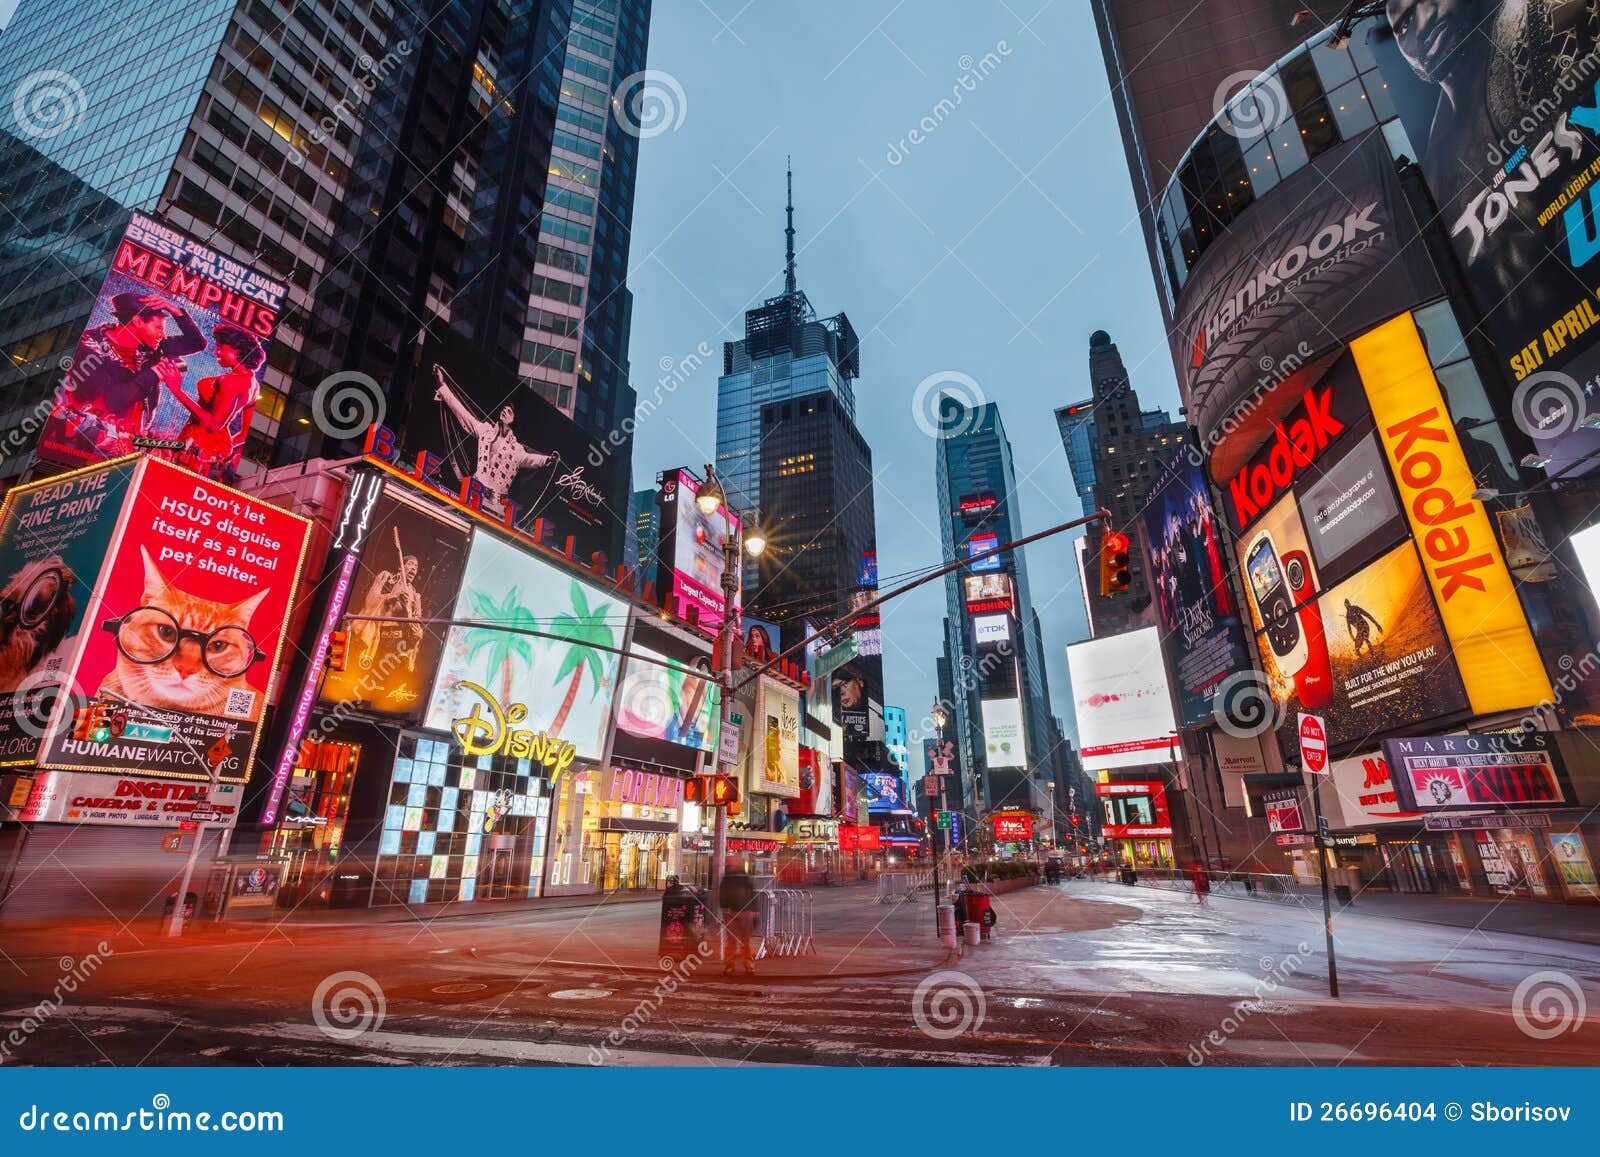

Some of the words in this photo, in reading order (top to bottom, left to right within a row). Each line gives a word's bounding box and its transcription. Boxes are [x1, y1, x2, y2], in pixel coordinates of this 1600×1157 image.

[1491, 168, 1507, 189] JON
[1504, 144, 1528, 174] BONES
[1536, 192, 1568, 228] WORLD
[1566, 168, 1593, 200] LIGHT
[125, 223, 187, 264] BEST
[190, 256, 281, 310] MUSICAL
[185, 240, 217, 264] 2010
[214, 254, 248, 278] TONY
[248, 271, 287, 298] AWARD
[1284, 230, 1385, 294] emotion
[115, 242, 277, 337] MEMPHIS
[1509, 338, 1545, 382] SAT
[1541, 298, 1600, 358] APRIL
[134, 436, 183, 448] LAMAR
[1229, 386, 1345, 530] Kodak
[30, 482, 74, 508] READ
[77, 471, 110, 495] THE
[192, 486, 242, 516] Don't
[243, 505, 266, 526] let
[663, 493, 676, 502] LG
[1386, 405, 1495, 604] Kodak
[17, 505, 56, 531] FINE
[56, 492, 108, 521] PRINT
[160, 496, 212, 527] HSUS
[215, 513, 281, 551] disguise
[151, 516, 201, 544] itself
[202, 535, 223, 551] as
[225, 543, 238, 557] a
[240, 546, 279, 571] local
[159, 545, 193, 566] pet
[197, 555, 259, 586] shelter.
[328, 579, 348, 626] SEXY
[967, 601, 1012, 613] TOSHIBA
[983, 623, 1006, 633] TDK
[308, 633, 330, 684] REEL
[1344, 675, 1360, 690] BUILT
[1360, 671, 1374, 684] FOR
[1372, 666, 1386, 680] THE
[1384, 659, 1400, 674] WAY
[1400, 654, 1417, 668] YOU
[1416, 645, 1438, 662] PLAY.
[130, 728, 150, 737] Av
[183, 726, 193, 735] of
[194, 727, 205, 736] its
[184, 714, 195, 723] of
[195, 716, 211, 726] the
[291, 689, 313, 740] SEXY
[1303, 726, 1311, 735] DO
[1310, 727, 1321, 738] NOT
[270, 749, 295, 803] REEL
[1306, 751, 1322, 762] ENTER
[1412, 757, 1429, 769] RICKY
[1428, 757, 1449, 768] MARTIN
[72, 796, 142, 811] CAMERAS
[146, 800, 158, 812] &
[609, 767, 684, 808] FOREVER
[1464, 765, 1555, 803] EVITA
[108, 812, 128, 820] PHOTO
